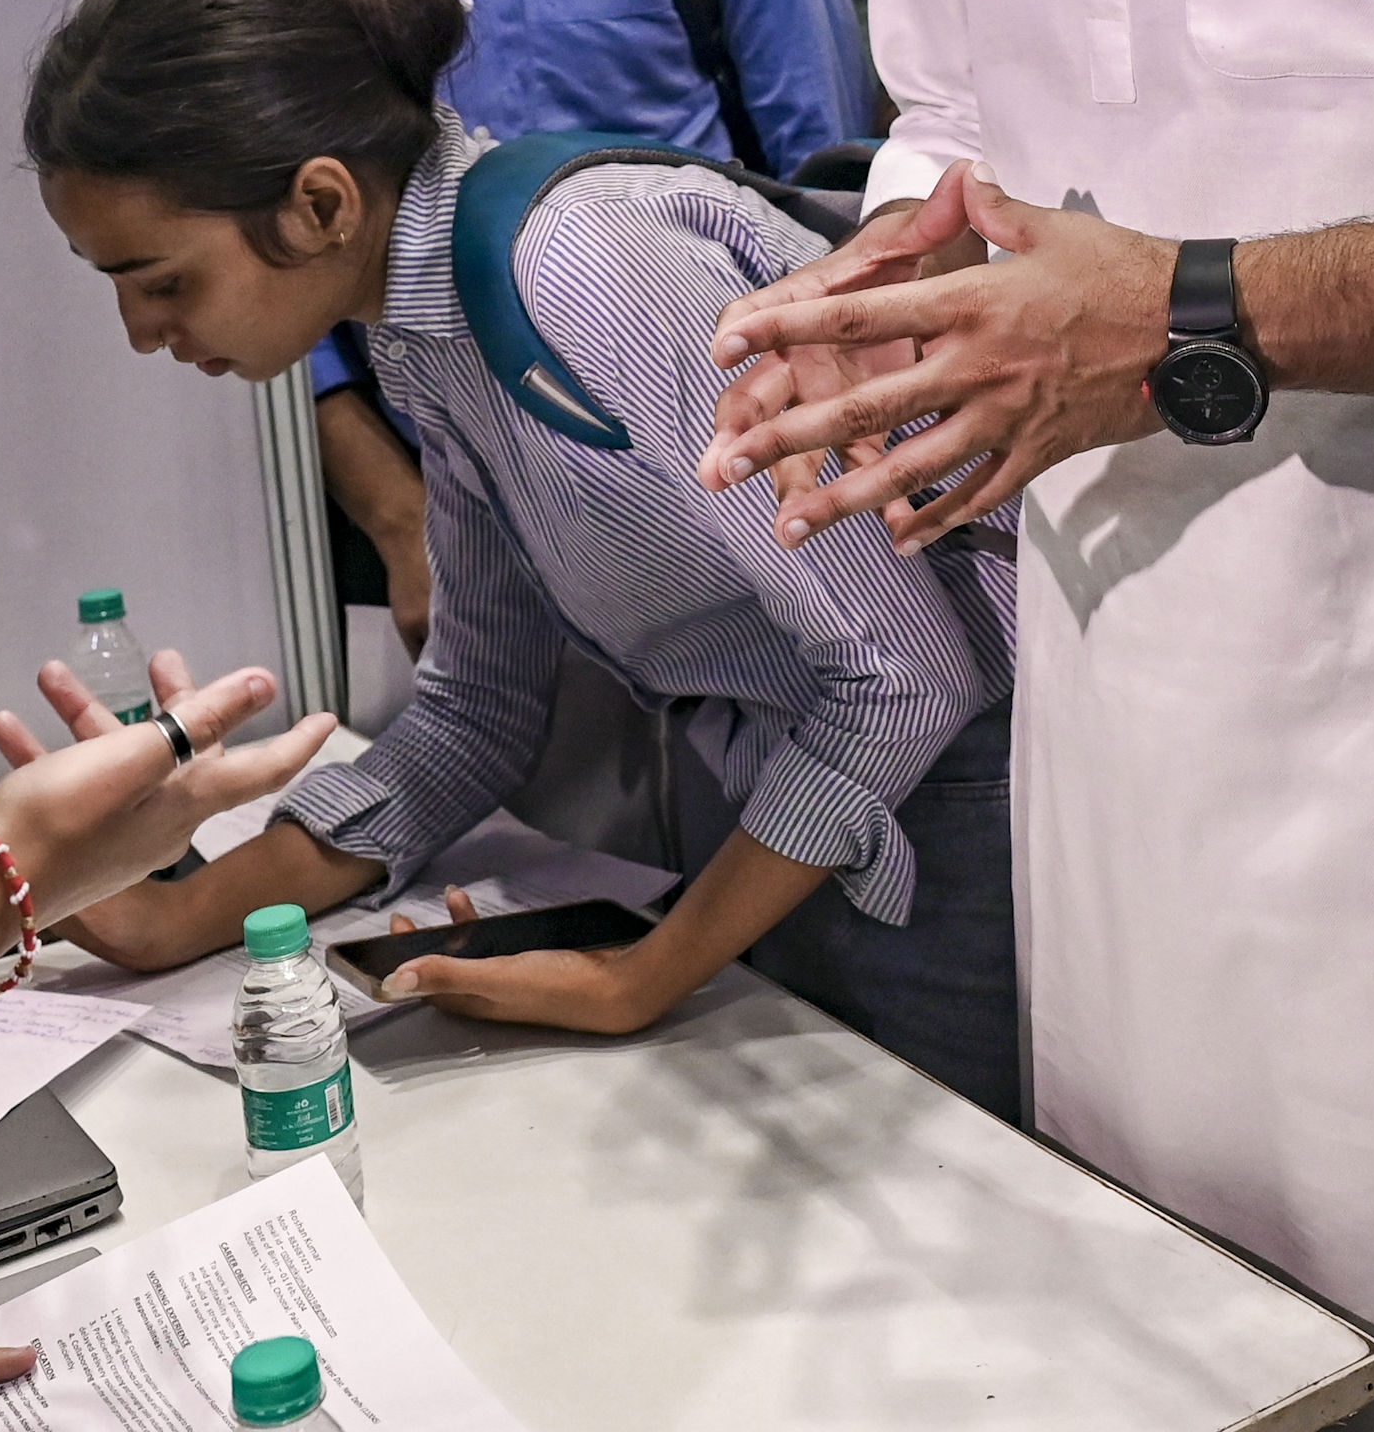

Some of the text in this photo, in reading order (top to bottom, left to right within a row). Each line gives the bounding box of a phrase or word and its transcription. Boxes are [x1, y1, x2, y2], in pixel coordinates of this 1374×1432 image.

[254, 1225, 267, 1242] Date
[267, 1249, 280, 1267] Birth
[287, 1209, 322, 1262] Roshan Kumar
[219, 1241, 257, 1303] CAREER OBJECTIVE
[147, 1270, 190, 1348] WORKING EXPERIENCE
[31, 1337, 56, 1380] EDUCATION
